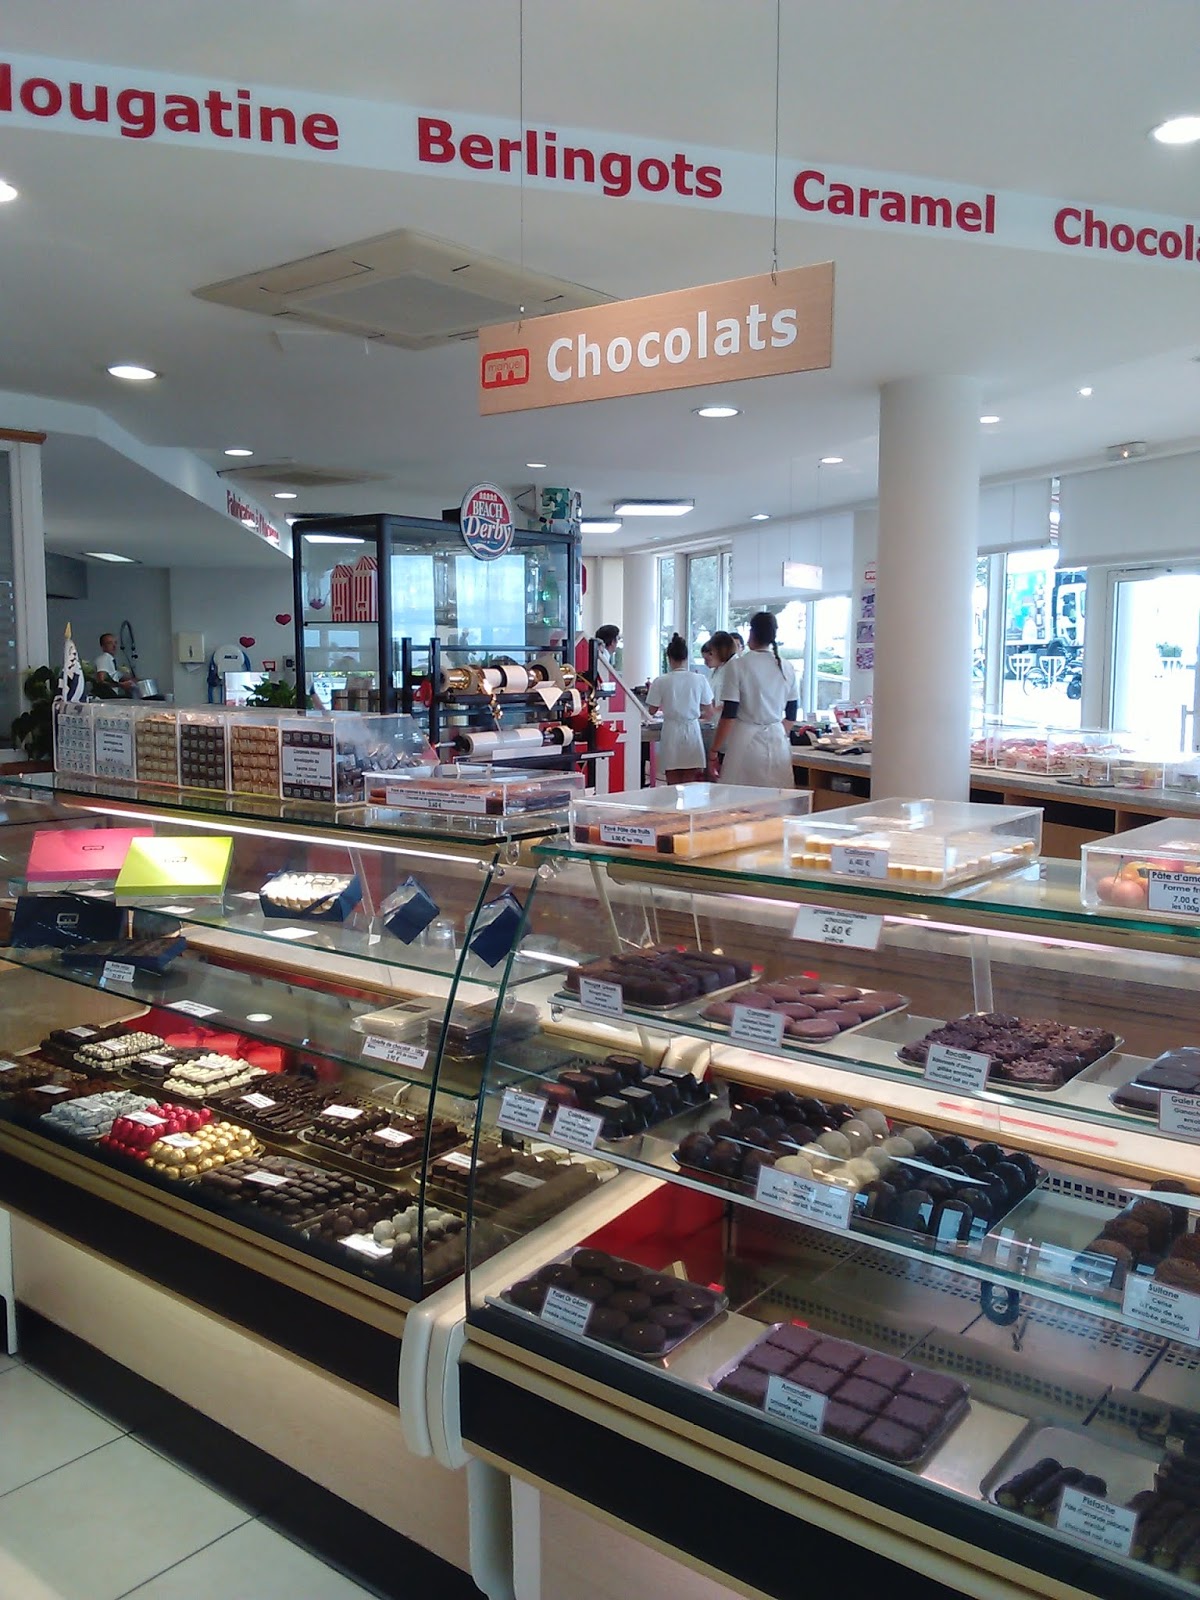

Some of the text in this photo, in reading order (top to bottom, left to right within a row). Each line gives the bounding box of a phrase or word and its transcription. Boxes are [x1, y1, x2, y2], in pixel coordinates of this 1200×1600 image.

[418, 116, 723, 199] Berlingots
[793, 169, 996, 234] Caramel
[547, 303, 799, 384] Chocolats
[472, 499, 503, 519] BEACH
[465, 516, 511, 543] Derby
[1152, 871, 1172, 880] Pâte
[1163, 884, 1191, 892] Forme
[1173, 896, 1199, 905] 7.00 €
[1184, 904, 1200, 913] 100g
[822, 924, 852, 936] 3.60 €
[945, 1049, 972, 1060] Rocaille
[1171, 1095, 1194, 1106] Galet
[1148, 1283, 1179, 1299] Sultane
[1151, 1297, 1172, 1309] Cerise
[1173, 1313, 1184, 1321] vie
[781, 1383, 812, 1400] Amandier
[1082, 1496, 1116, 1515] Pistache
[1077, 1508, 1106, 1523] d'amande
